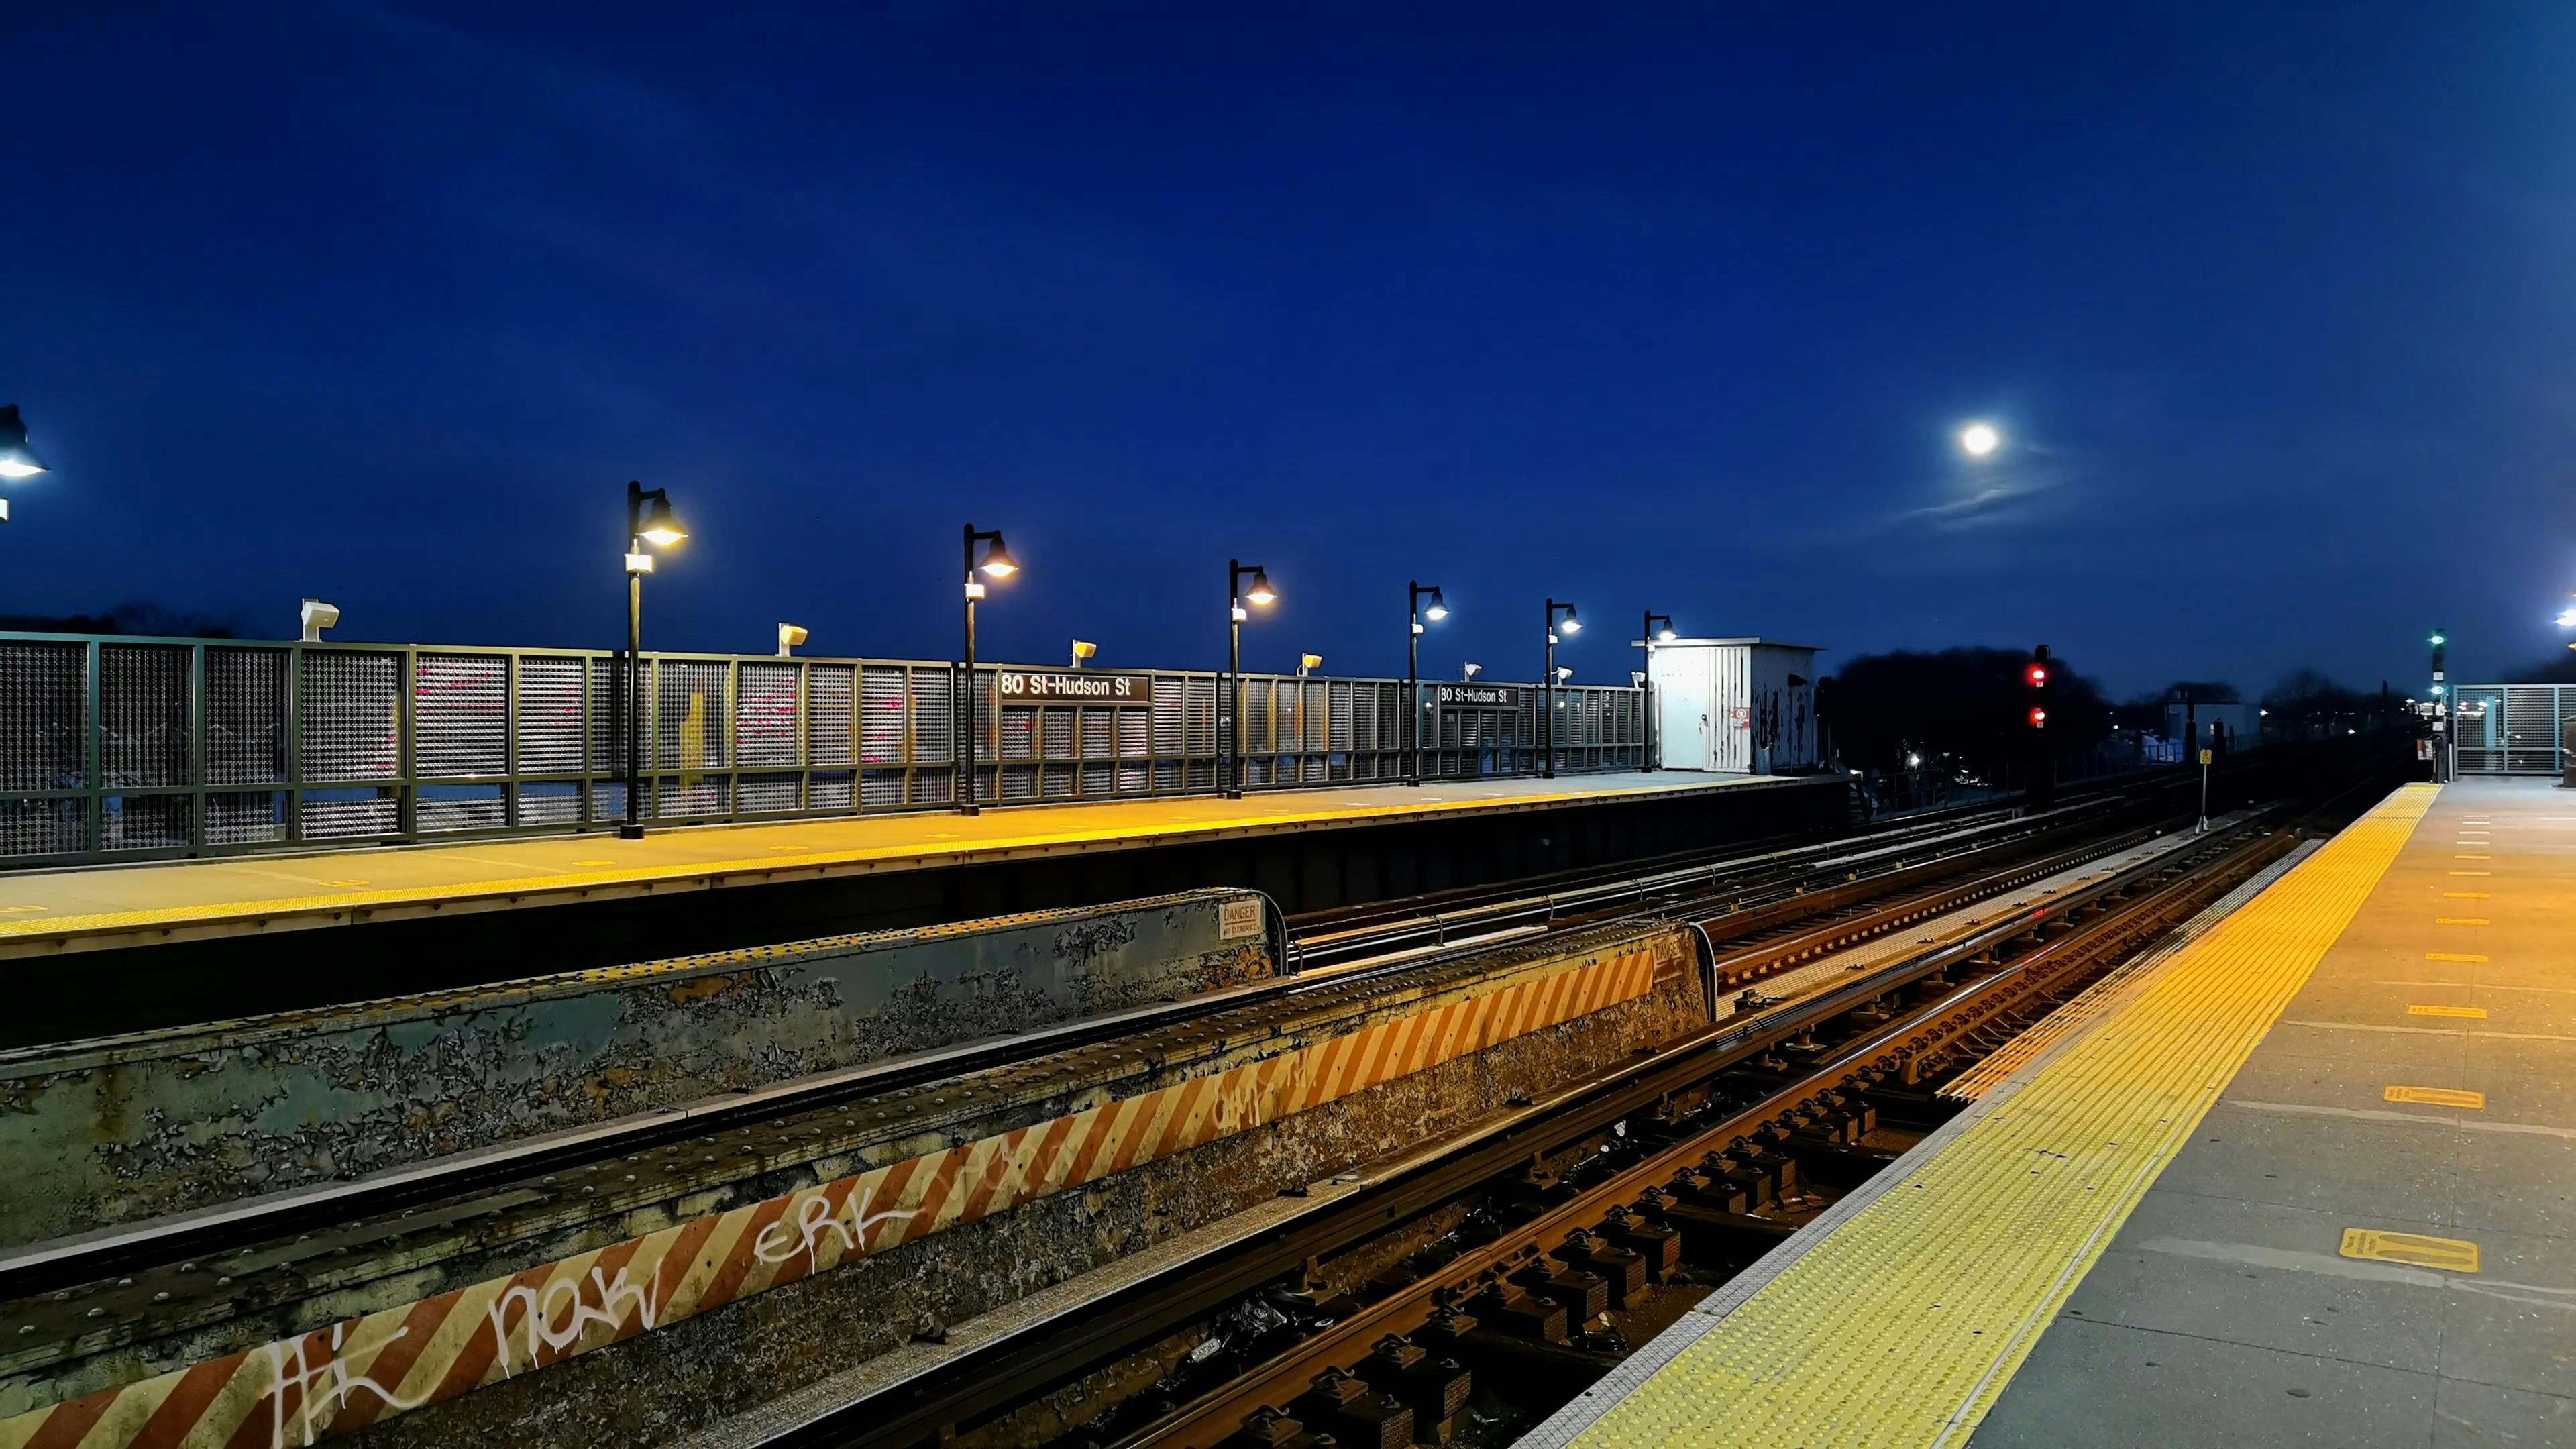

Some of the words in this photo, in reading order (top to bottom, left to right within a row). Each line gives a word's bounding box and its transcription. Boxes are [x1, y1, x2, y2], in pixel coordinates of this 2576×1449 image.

[1001, 674, 1024, 694] 80
[1030, 675, 1110, 696] St-Hudson
[1115, 678, 1131, 696] St
[1455, 688, 1496, 702] St-Hudson
[1498, 689, 1507, 703] St
[1224, 904, 1256, 922] DANGER
[1655, 940, 1682, 961] DANGER
